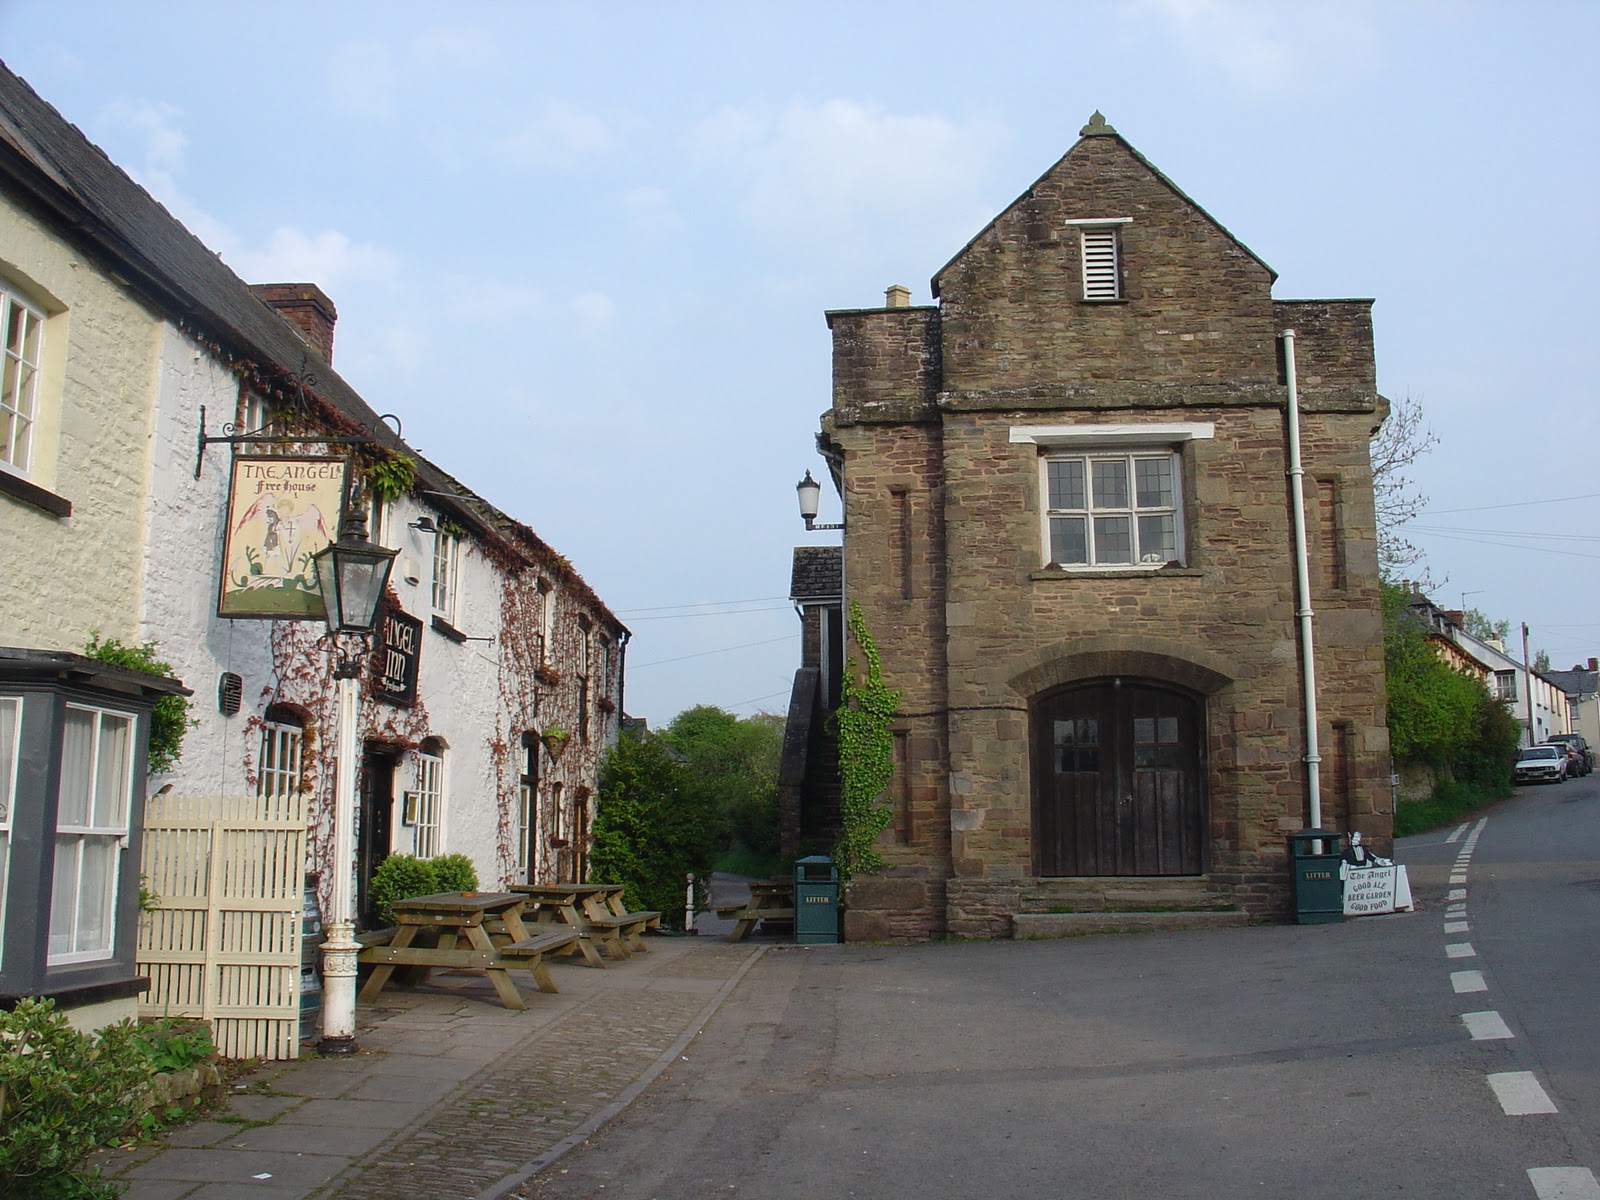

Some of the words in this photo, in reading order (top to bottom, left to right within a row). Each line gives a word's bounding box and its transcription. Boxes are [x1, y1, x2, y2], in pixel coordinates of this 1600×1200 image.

[1350, 872, 1365, 880] The
[1368, 870, 1391, 879] Angel
[1353, 882, 1371, 892] GOOD
[1373, 882, 1387, 890] ALE
[1366, 891, 1392, 900] GARDEN
[1351, 903, 1368, 911] GOOD
[1370, 900, 1388, 911] FOOD
